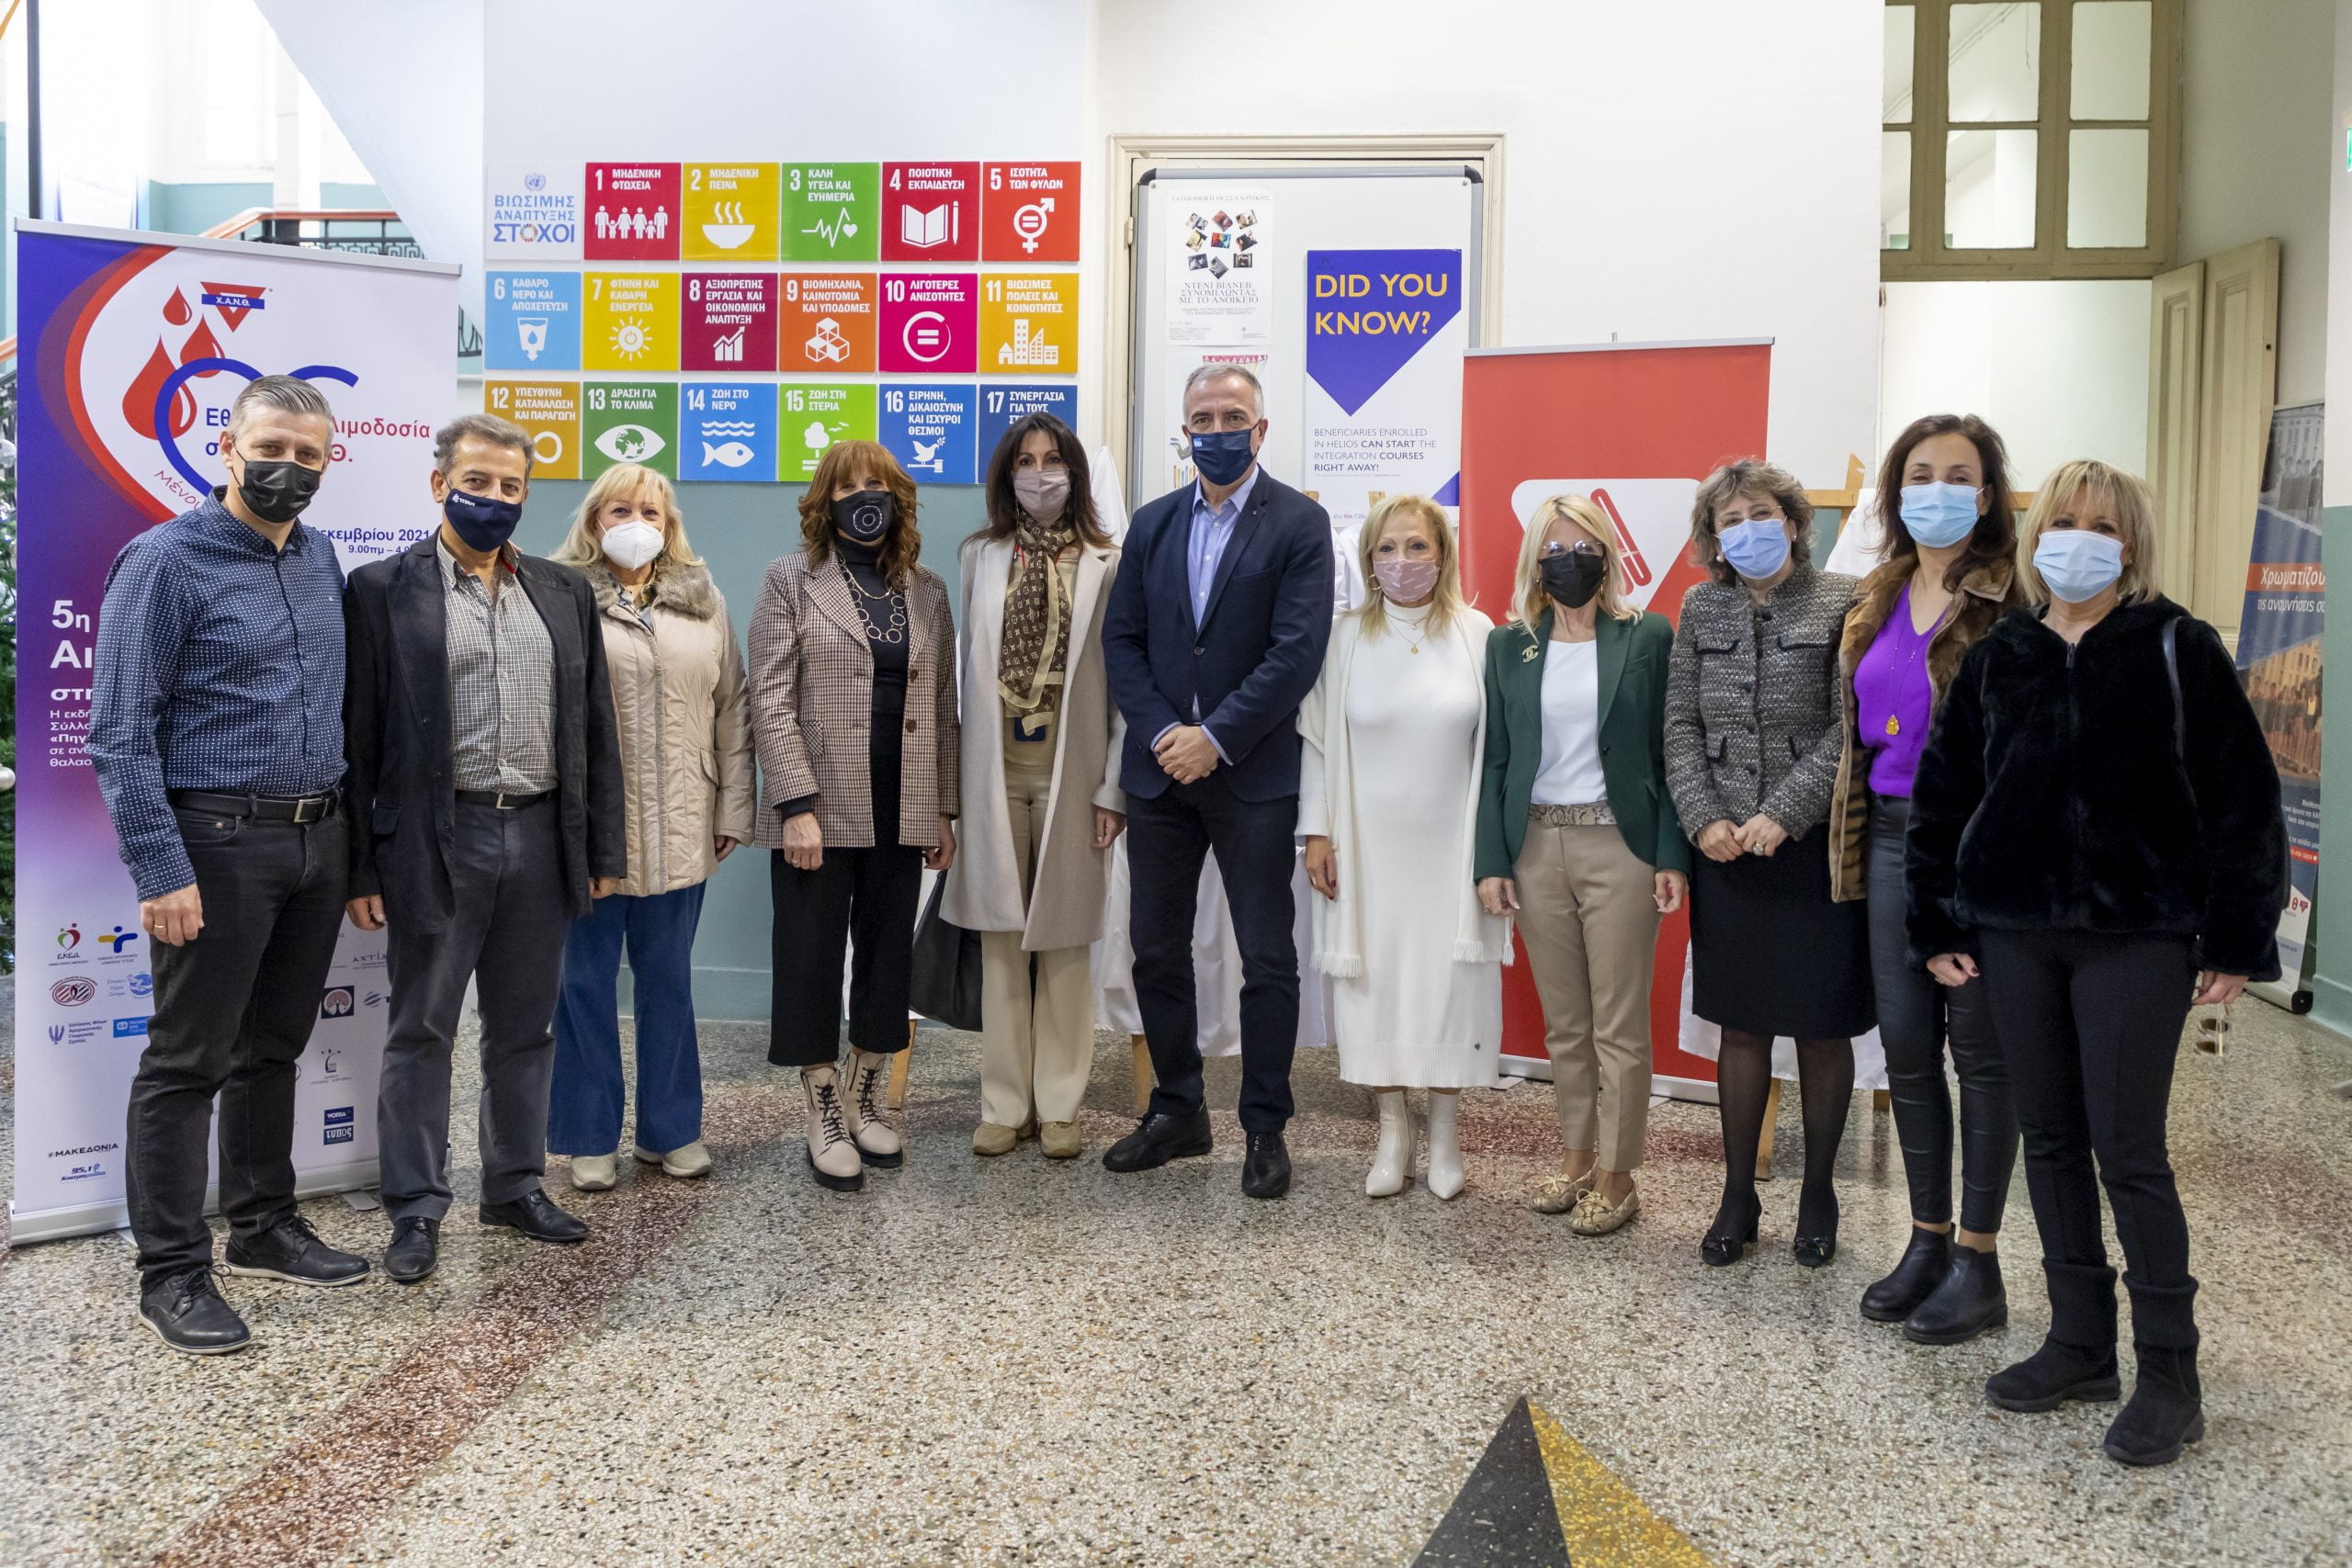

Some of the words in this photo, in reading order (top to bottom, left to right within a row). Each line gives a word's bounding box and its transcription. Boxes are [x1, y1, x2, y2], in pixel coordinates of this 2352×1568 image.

[613, 169, 661, 178] ΜΗΔΕΝΙΚΗ
[710, 169, 759, 178] ΜΗΔΕΝΙΚΗ
[808, 169, 833, 178] ΚΑΛΗ
[909, 168, 952, 178] ΠΟΙΟΤΙΚΗ
[1011, 168, 1047, 177] ΙΣΟΤΗΤΑ
[595, 170, 603, 191] 1
[691, 169, 701, 191] 2
[790, 169, 800, 190] 3
[889, 169, 900, 190] 4
[990, 169, 1001, 190] 5
[1011, 180, 1028, 189] ΤΩΝ
[1030, 179, 1063, 189] ΦΥΛΩΝ
[612, 180, 650, 190] ΦΤΩΧΕΙΑ
[710, 180, 738, 190] ΠΕΙΝΑ
[808, 181, 833, 190] ΥΓΕΙΑ
[835, 181, 851, 189] ΚΑΙ
[909, 180, 965, 190] ΕΚΠΑΙΔΕΥΣΗ
[495, 196, 574, 208] ΒΙΩΣΙΜΗΣ
[808, 192, 854, 202] ΕΥΗΜΕΡΙΑ
[494, 210, 574, 220] ΑΝΑΠΤΥΞΗΣ
[513, 278, 548, 288] ΚΑΘΑΡΟ
[610, 279, 641, 288] ΦΤΗΝΗ
[644, 279, 659, 288] ΚΑΙ
[706, 279, 763, 288] ΑΞΙΟΠΡΕΠΗΣ
[803, 280, 864, 290] ΒΙΟΜΗΧΑΝΙΑ,
[910, 280, 959, 289] ΛΙΓΟΤΕΡΕΣ
[1007, 280, 1052, 289] ΒΙΩΣΙΜΕΣ
[1316, 274, 1370, 298] DID
[1380, 274, 1447, 297] YOU
[494, 279, 504, 299] 6
[593, 279, 603, 300] 7
[689, 280, 700, 301] 8
[786, 280, 797, 301] 9
[886, 280, 905, 301] 10
[987, 280, 1001, 301] 11
[513, 290, 537, 299] ΝΕΡΟ
[538, 290, 553, 299] ΚΑΙ
[610, 290, 647, 300] ΚΑΘΑΡΗ
[707, 291, 743, 300] ΕΡΓΑΣΙΑ
[747, 291, 763, 300] ΚΑΙ
[803, 291, 860, 300] ΚΑΙΝΟΤΟΜΙΑ
[910, 292, 965, 301] ΑΝΙΣΟΤΗΤΕΣ
[1007, 292, 1041, 301] ΠΟΛΕΙΣ
[1043, 292, 1058, 300] ΚΑΙ
[216, 297, 250, 306] Χ.Α.Ν.Θ.
[512, 302, 568, 311] ΑΠΟΧΕΤΕΥΣΗ
[610, 302, 653, 312] ΕΝΕΡΓΕΙΑ
[706, 303, 765, 312] ΟΙΚΟΝΟΜΙΚΗ
[803, 303, 818, 312] ΚΑΙ
[820, 303, 870, 312] ΥΠΟΔΟΜΕΣ
[1007, 303, 1063, 313] ΚΟΙΝΟΤΗΤΕΣ
[706, 315, 752, 324] ΑΝΑΠΤΥΞΗ
[1316, 311, 1430, 334] KNOW?
[515, 388, 561, 397] ΥΠΕΥΘΥΝΗ
[611, 389, 640, 398] ΔΡΑΣΗ
[642, 389, 656, 398] ΓΙΑ
[712, 389, 730, 399] ΖΩΗ
[733, 389, 749, 399] ΣΤΟ
[808, 390, 828, 400] ΖΩΗ
[831, 390, 846, 400] ΣΤΗ
[909, 390, 946, 400] ΕΙΡΗΝΗ,
[1010, 391, 1065, 400] ΣΥΝΕΡΓΑΣΙΑ
[492, 388, 508, 409] 12
[588, 389, 605, 410] 13
[687, 389, 705, 411] 14
[786, 390, 803, 412] 15
[885, 391, 903, 412] 16
[988, 391, 1004, 412] 17
[515, 400, 573, 409] ΚΑΤΑΝΑΛΩΣΗ
[611, 400, 622, 410] ΤΟ
[624, 400, 653, 410] ΚΛΙΜΑ
[712, 400, 736, 411] ΝΕΡΟ
[808, 401, 839, 411] ΣΤΕΡΙΑ
[909, 403, 963, 412] ΔΙΚΑΙΟΣΥΝΗ
[1010, 403, 1023, 412] ΓΙΑ
[1026, 403, 1048, 412] ΤΟΥΣ
[515, 411, 529, 420] ΚΑΙ
[531, 411, 575, 421] ΠΑΡΑΓΩΓΗ
[909, 415, 924, 423] ΚΑΙ
[926, 415, 960, 423] ΙΣΧΥΡΟΙ
[909, 426, 944, 435] ΘΕΣΜΟΙ
[399, 529, 429, 541] 2021
[2261, 566, 2326, 590] Χρωματίζου
[51, 600, 90, 633] 5η
[51, 710, 60, 718] Η
[51, 721, 90, 731] Σύλλο
[51, 734, 87, 744] «Πηγ
